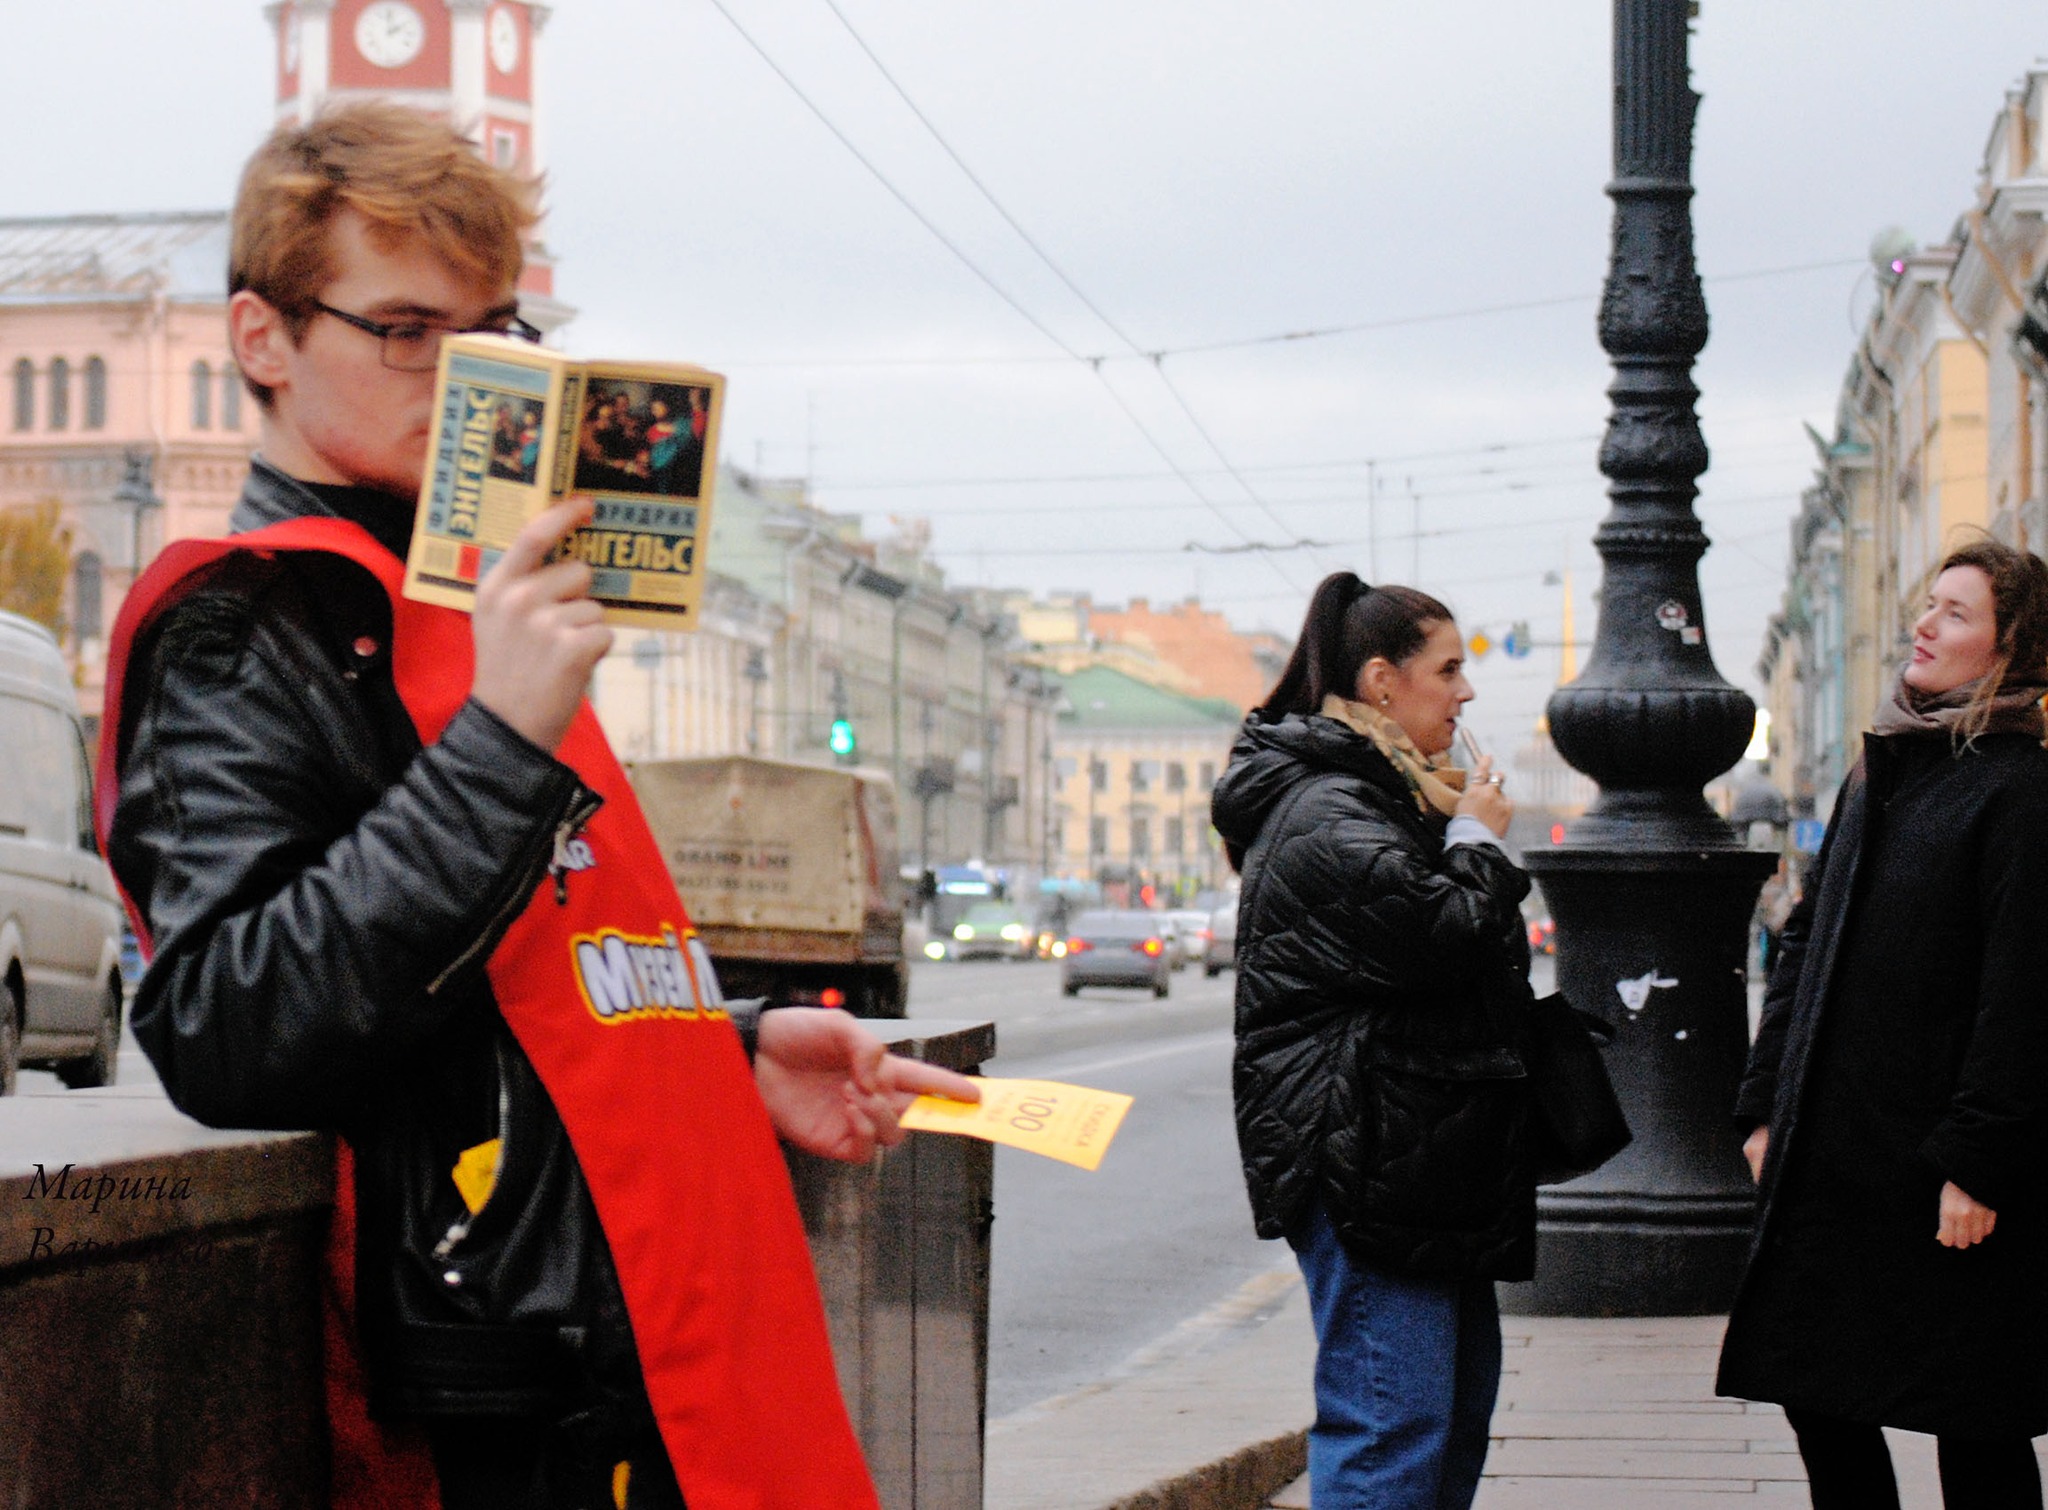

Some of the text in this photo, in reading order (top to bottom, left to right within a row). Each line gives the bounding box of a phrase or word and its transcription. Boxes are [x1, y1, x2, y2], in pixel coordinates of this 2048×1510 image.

[429, 387, 462, 528] ФРИДРИХ
[450, 388, 494, 536] ЭНГЕЛЬС
[1010, 1096, 1058, 1132] 100
